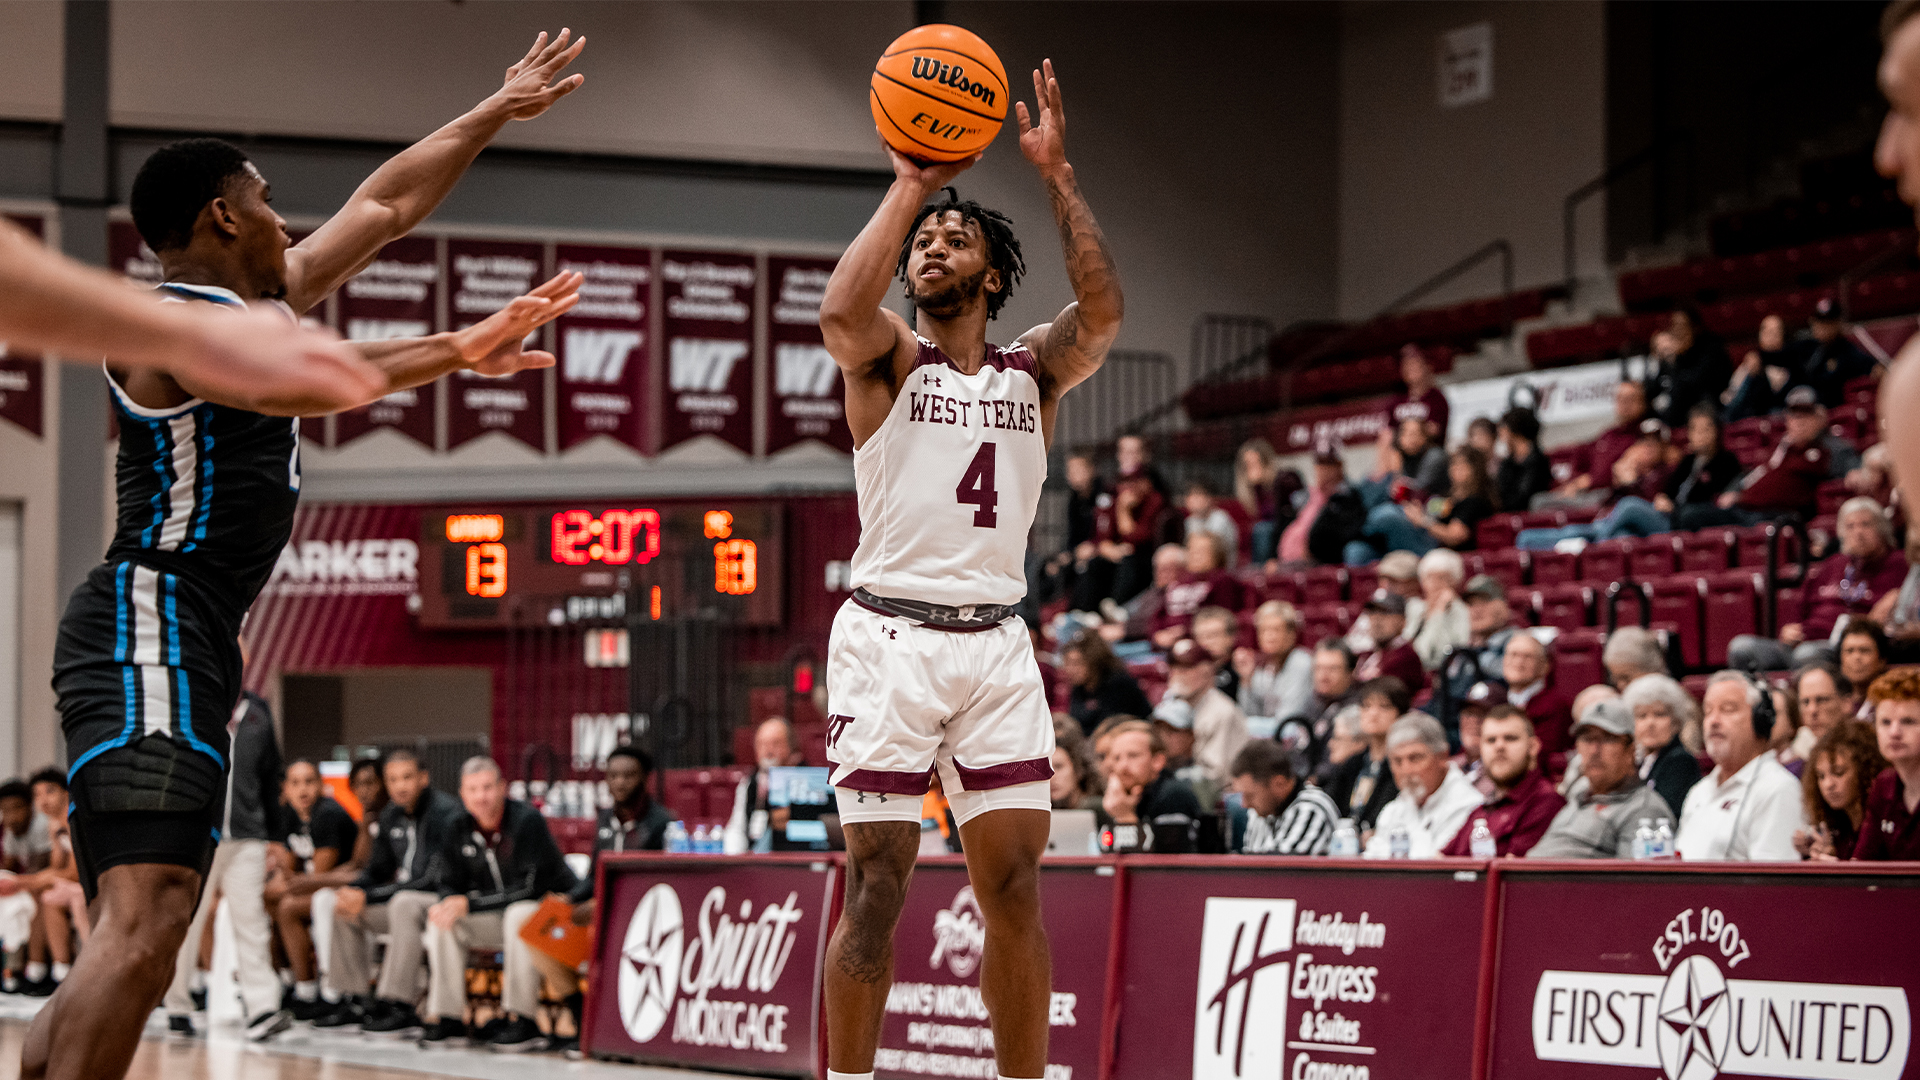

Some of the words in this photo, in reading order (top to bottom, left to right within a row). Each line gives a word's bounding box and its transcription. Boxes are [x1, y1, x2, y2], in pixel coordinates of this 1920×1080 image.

[911, 56, 996, 108] Wilson
[911, 112, 966, 141] EVO
[910, 391, 971, 428] WEST
[979, 399, 1035, 434] TEXAS
[956, 441, 998, 529] 4
[276, 538, 419, 583] ARKER
[466, 543, 507, 597] 13
[680, 885, 803, 1000] Spirit
[1296, 909, 1357, 955] Holiday
[1357, 911, 1386, 949] Inn
[1652, 908, 1697, 971] EST.
[1700, 906, 1751, 969] 1907
[1291, 953, 1379, 1011] Express
[672, 998, 789, 1052] MORTGAGE
[1299, 1010, 1315, 1041] &
[1314, 1011, 1361, 1045] Suites
[1546, 988, 1656, 1049] FIRST
[1736, 997, 1894, 1066] UNITED
